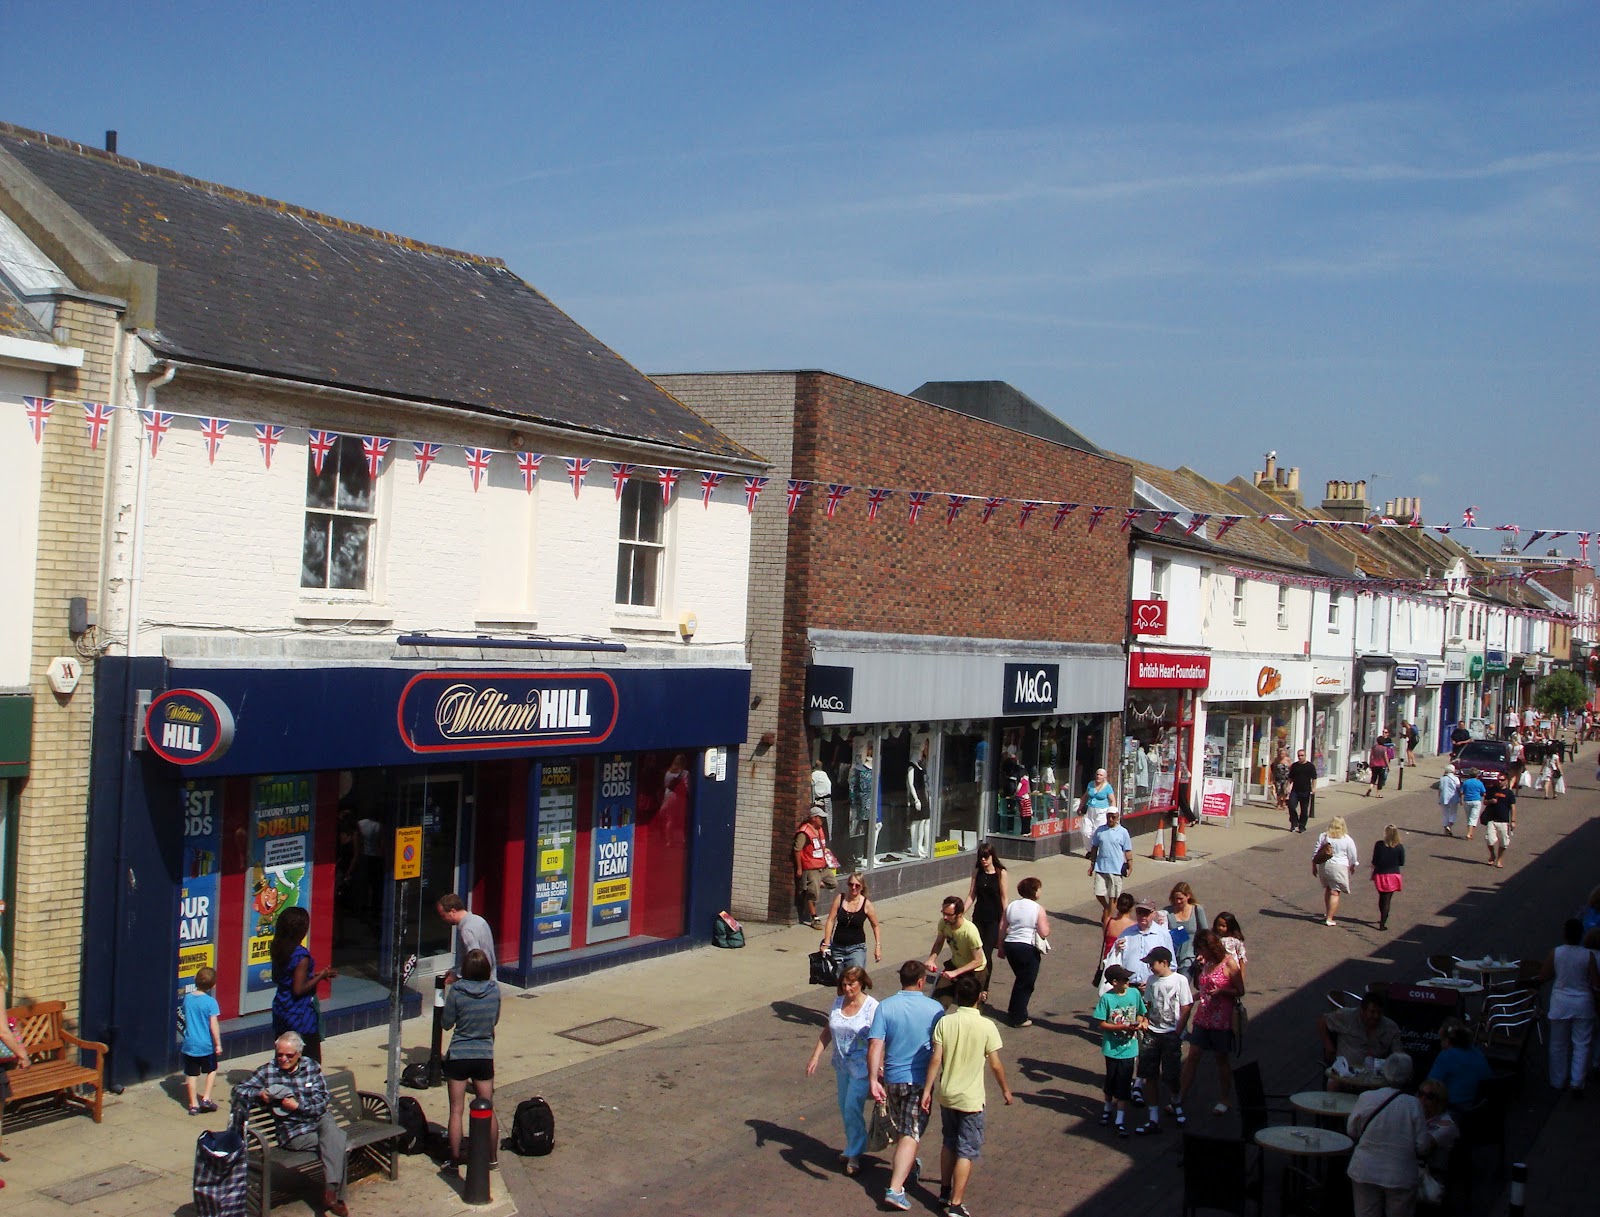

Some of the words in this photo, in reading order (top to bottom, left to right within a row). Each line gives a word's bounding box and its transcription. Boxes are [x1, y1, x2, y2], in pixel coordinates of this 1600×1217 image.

[1139, 662, 1158, 678] British
[1160, 662, 1175, 678] Heart
[1176, 664, 1206, 679] Foundation
[1014, 670, 1052, 704] M&Co.
[434, 684, 541, 736] William
[540, 689, 591, 729] HILL
[810, 695, 844, 710] M&Co.
[165, 702, 204, 723] William
[162, 722, 202, 752] HILL
[542, 774, 571, 785] ACTION
[603, 762, 632, 782] BEST
[259, 782, 294, 804] WIN
[602, 781, 631, 798] ODDS
[285, 805, 300, 815] TRIP
[301, 804, 310, 813] TO
[257, 815, 309, 838] DUBLIN
[1039, 824, 1050, 834] SALE
[1054, 822, 1064, 832] SALE
[599, 841, 628, 860] YOUR
[598, 857, 627, 876] TEAM
[536, 883, 550, 891] WILL
[552, 880, 567, 890] BOTH
[180, 917, 208, 940] AM
[252, 940, 267, 951] PLAY
[1408, 990, 1436, 1000] COSTA
